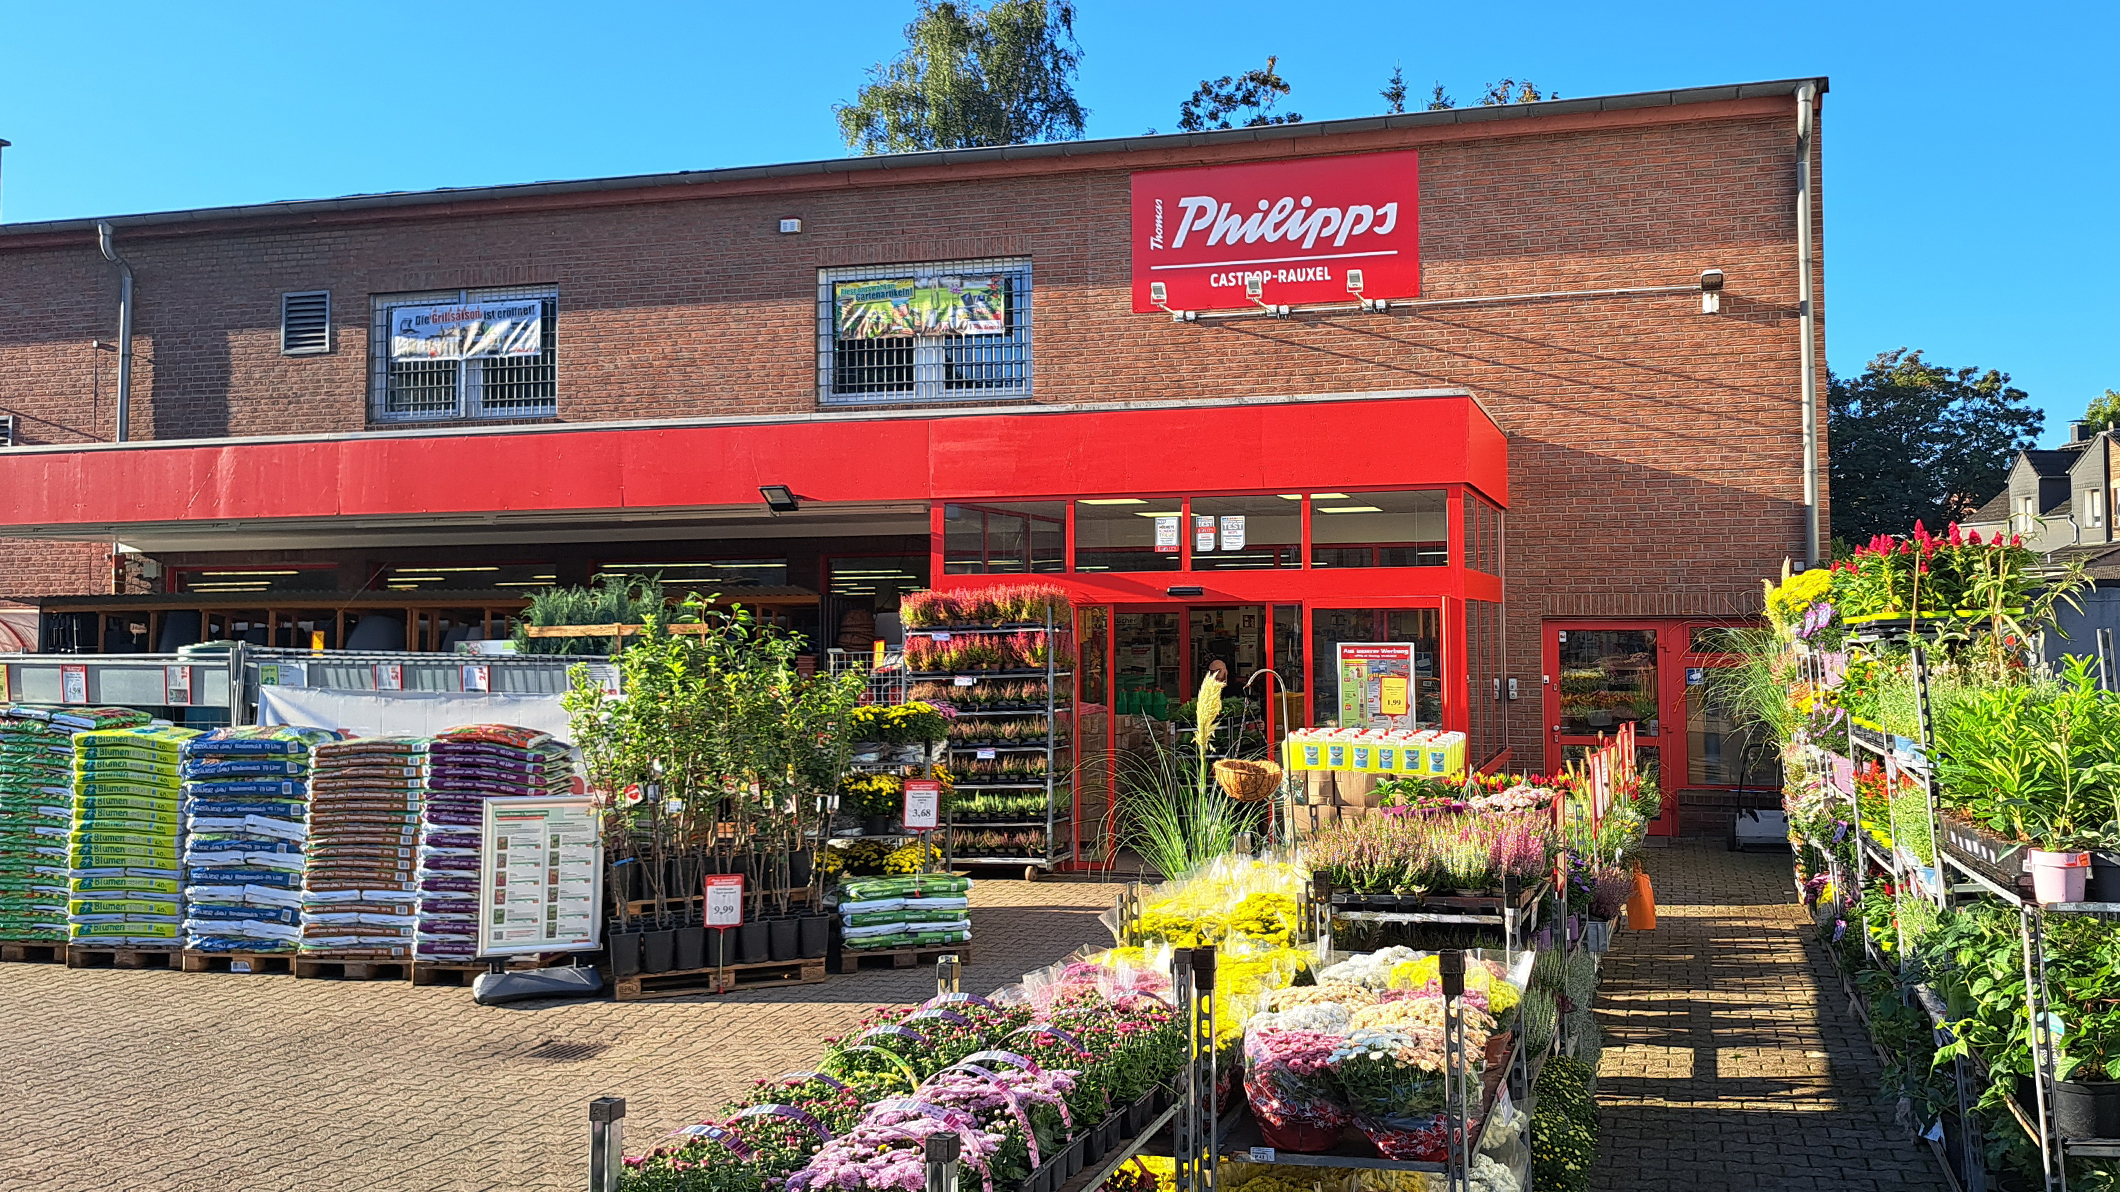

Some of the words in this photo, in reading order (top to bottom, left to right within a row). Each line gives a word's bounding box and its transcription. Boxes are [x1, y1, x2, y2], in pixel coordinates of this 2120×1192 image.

[1150, 199, 1164, 251] Thomas
[1171, 195, 1398, 250] Philipps
[415, 314, 430, 326] Die
[431, 310, 481, 324] Grillsaison
[483, 310, 496, 320] ist
[1222, 522, 1243, 531] TEST
[1115, 616, 1138, 624] ücher
[99, 748, 130, 757] Blumen
[98, 784, 130, 793] Blumen
[97, 797, 128, 805] Blumen
[97, 809, 128, 817] Blumen
[912, 808, 931, 818] 3,68
[94, 834, 125, 842] Blumen
[94, 845, 125, 854] Blumen
[94, 856, 126, 865] Blumen
[94, 877, 126, 886] Blumen
[94, 903, 126, 911] Blumen
[713, 905, 734, 916] 9,99
